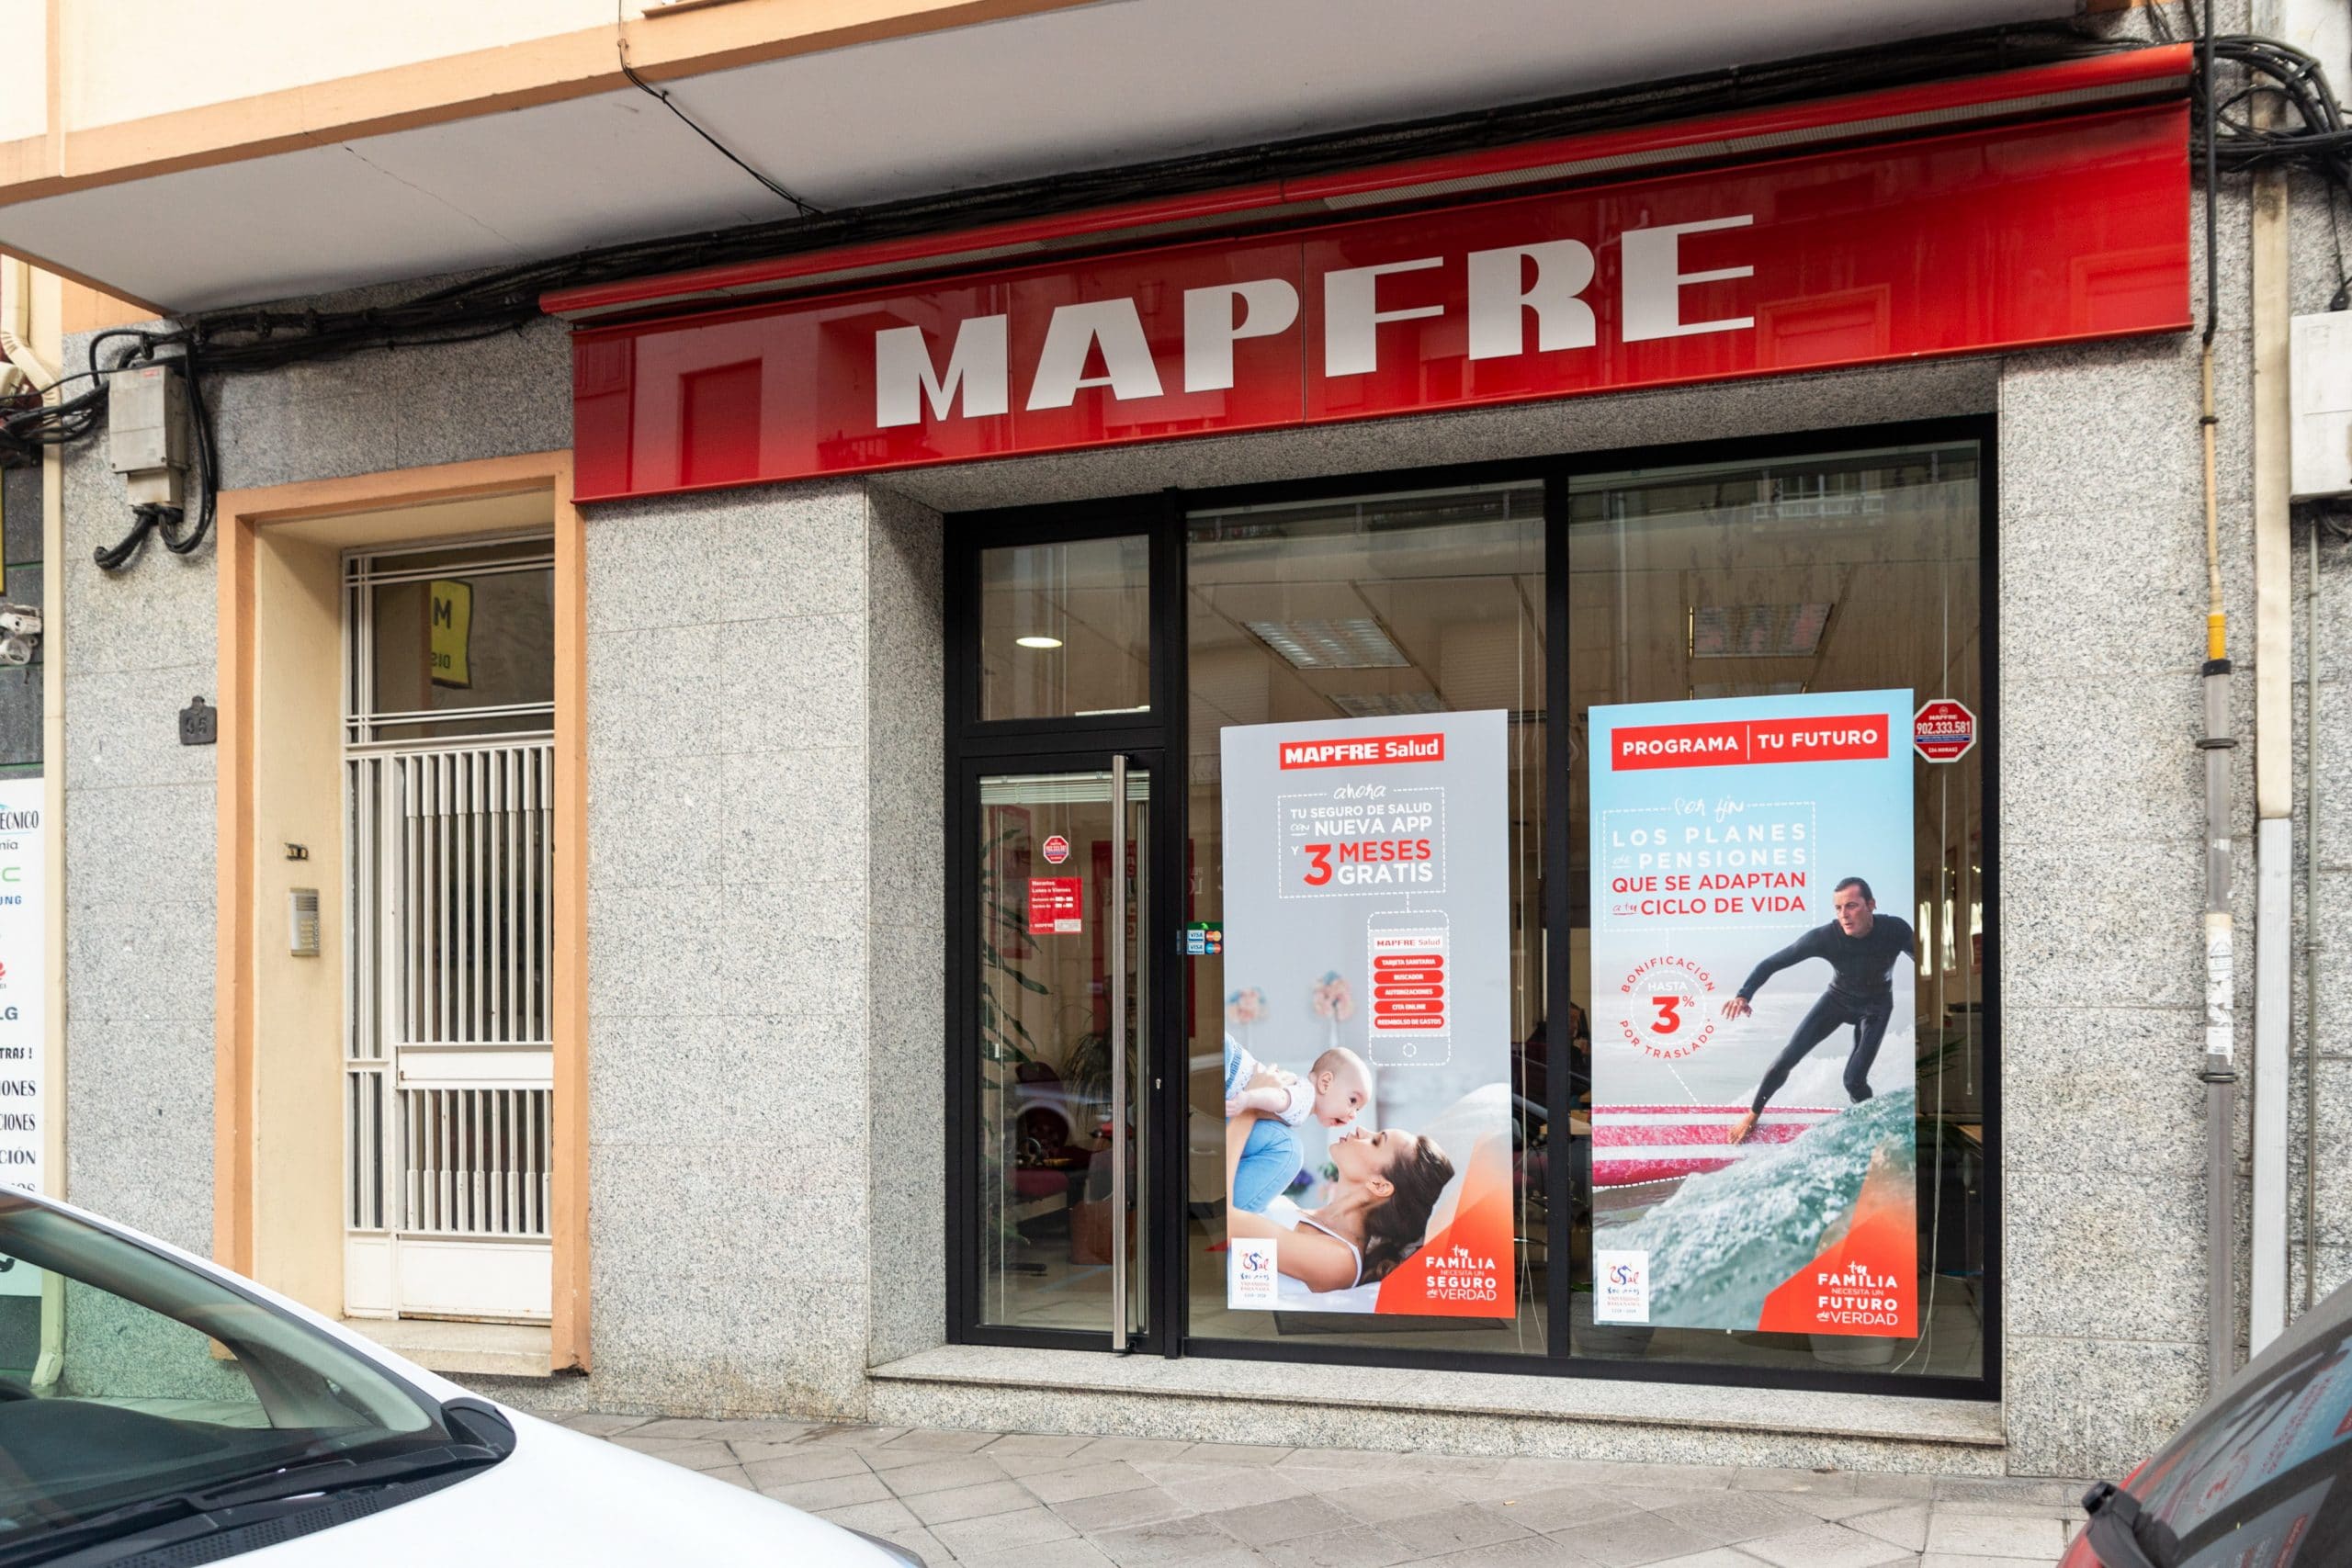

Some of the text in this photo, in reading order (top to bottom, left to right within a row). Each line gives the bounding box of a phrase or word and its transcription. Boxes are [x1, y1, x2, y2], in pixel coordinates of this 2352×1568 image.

[876, 214, 1754, 429] MAPFRE
[1917, 721, 1971, 735] 902.333.581
[1285, 739, 1439, 764] MAPFRE Salud
[1623, 729, 1879, 756] PROGRAMA TU FUTURO
[1333, 783, 1387, 800] ahora
[1290, 802, 1432, 819] TU SEGURO DE SALUD
[1315, 818, 1385, 837] NUEVA
[1391, 816, 1432, 833] APP
[1612, 823, 1806, 847] LOS PLANES
[1291, 839, 1431, 886] Y 3 MESES
[1638, 848, 1806, 869] PENSIONES
[1338, 863, 1433, 885] GRATIS
[1612, 872, 1806, 893] QUE SE ADAPTAN
[1641, 898, 1707, 915] CICLO
[1714, 897, 1744, 913] DE
[1751, 896, 1806, 912] VIDA
[1621, 955, 1715, 993] BONIFICACIÓN
[1647, 981, 1688, 991] HASTA
[1620, 1020, 1640, 1047] POR
[1452, 1244, 1469, 1258] tu
[1425, 1256, 1496, 1269] FAMILIA
[1848, 1260, 1868, 1276] tu
[1427, 1276, 1497, 1289] SEGURO
[1817, 1273, 1898, 1288] FAMILIA
[1439, 1288, 1498, 1301] VERDAD
[1817, 1295, 1898, 1311] FUTURO
[1829, 1311, 1898, 1325] VERDAD
